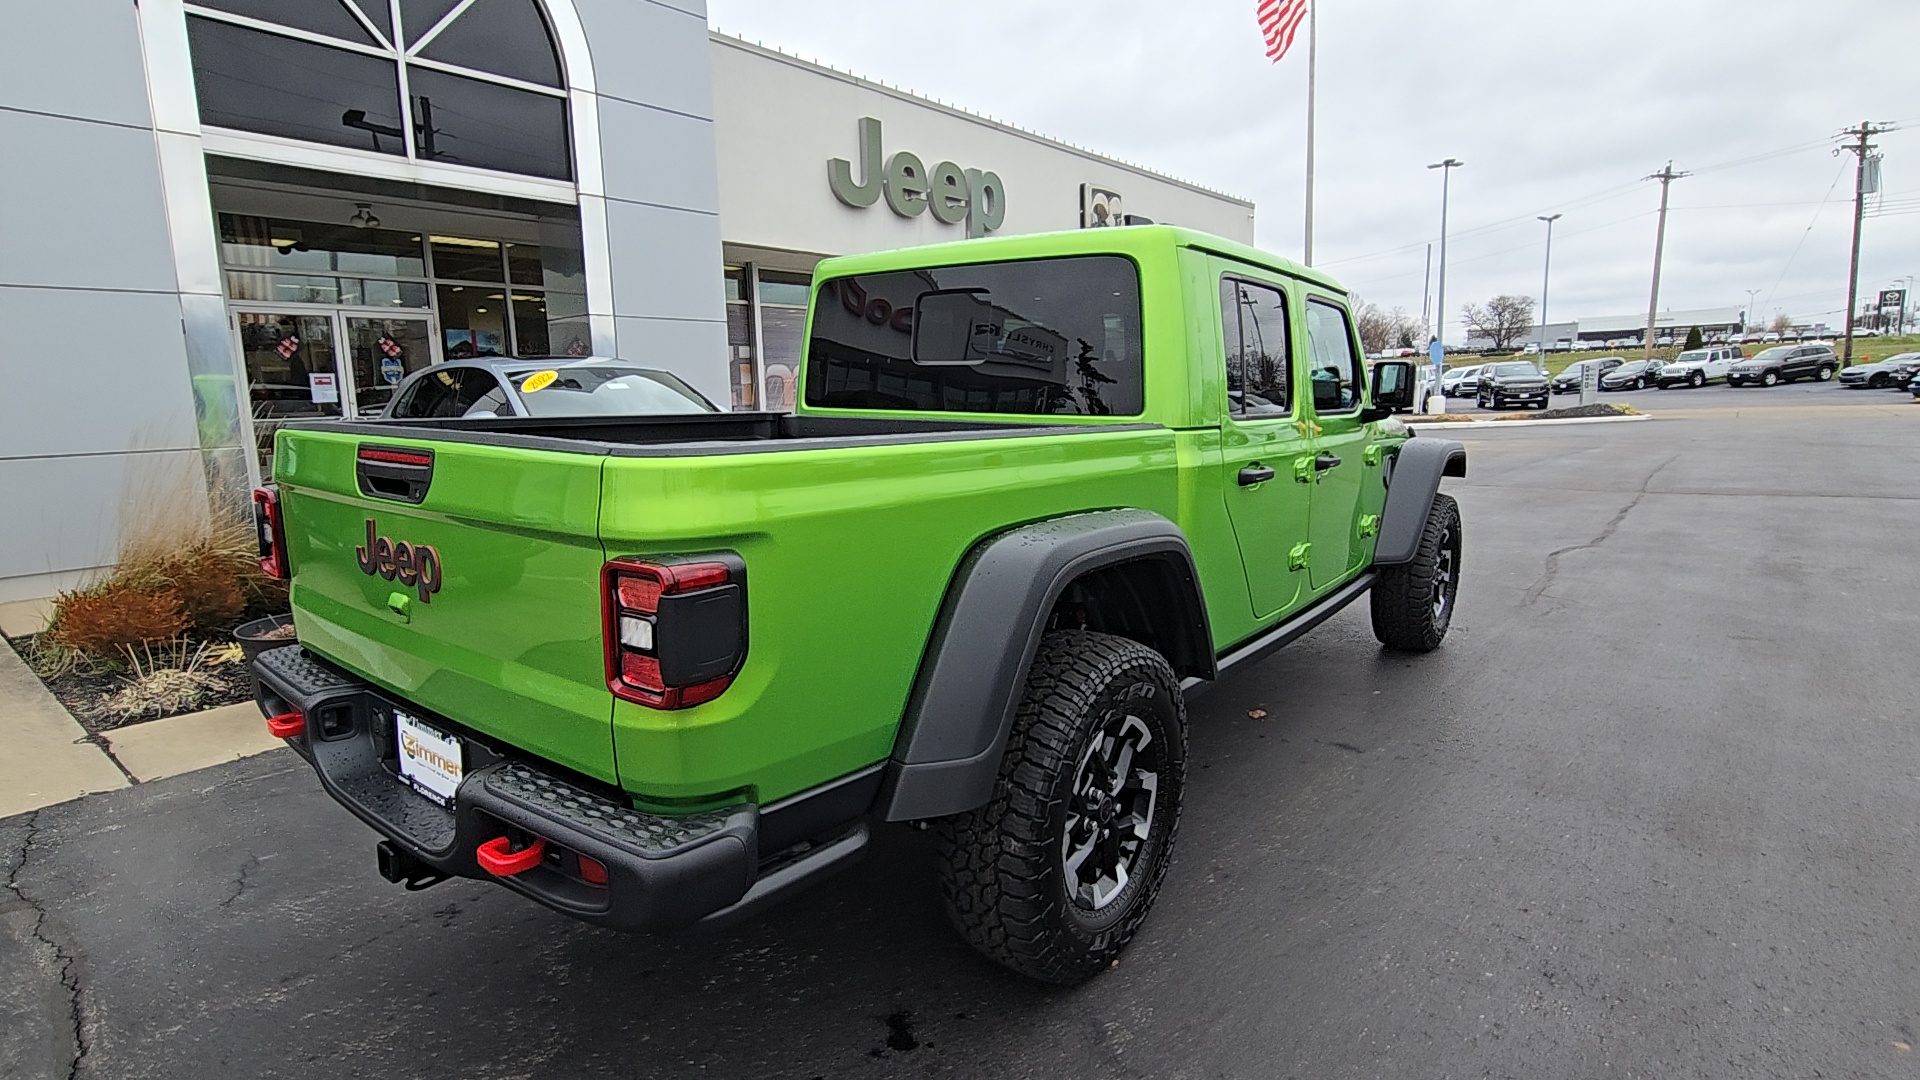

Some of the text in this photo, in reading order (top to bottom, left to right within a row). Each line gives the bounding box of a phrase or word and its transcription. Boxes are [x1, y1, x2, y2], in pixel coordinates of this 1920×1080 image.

[827, 116, 1006, 239] Jeep
[528, 372, 554, 390] 2022
[355, 517, 443, 605] Jeep
[404, 733, 463, 777] Zimmer
